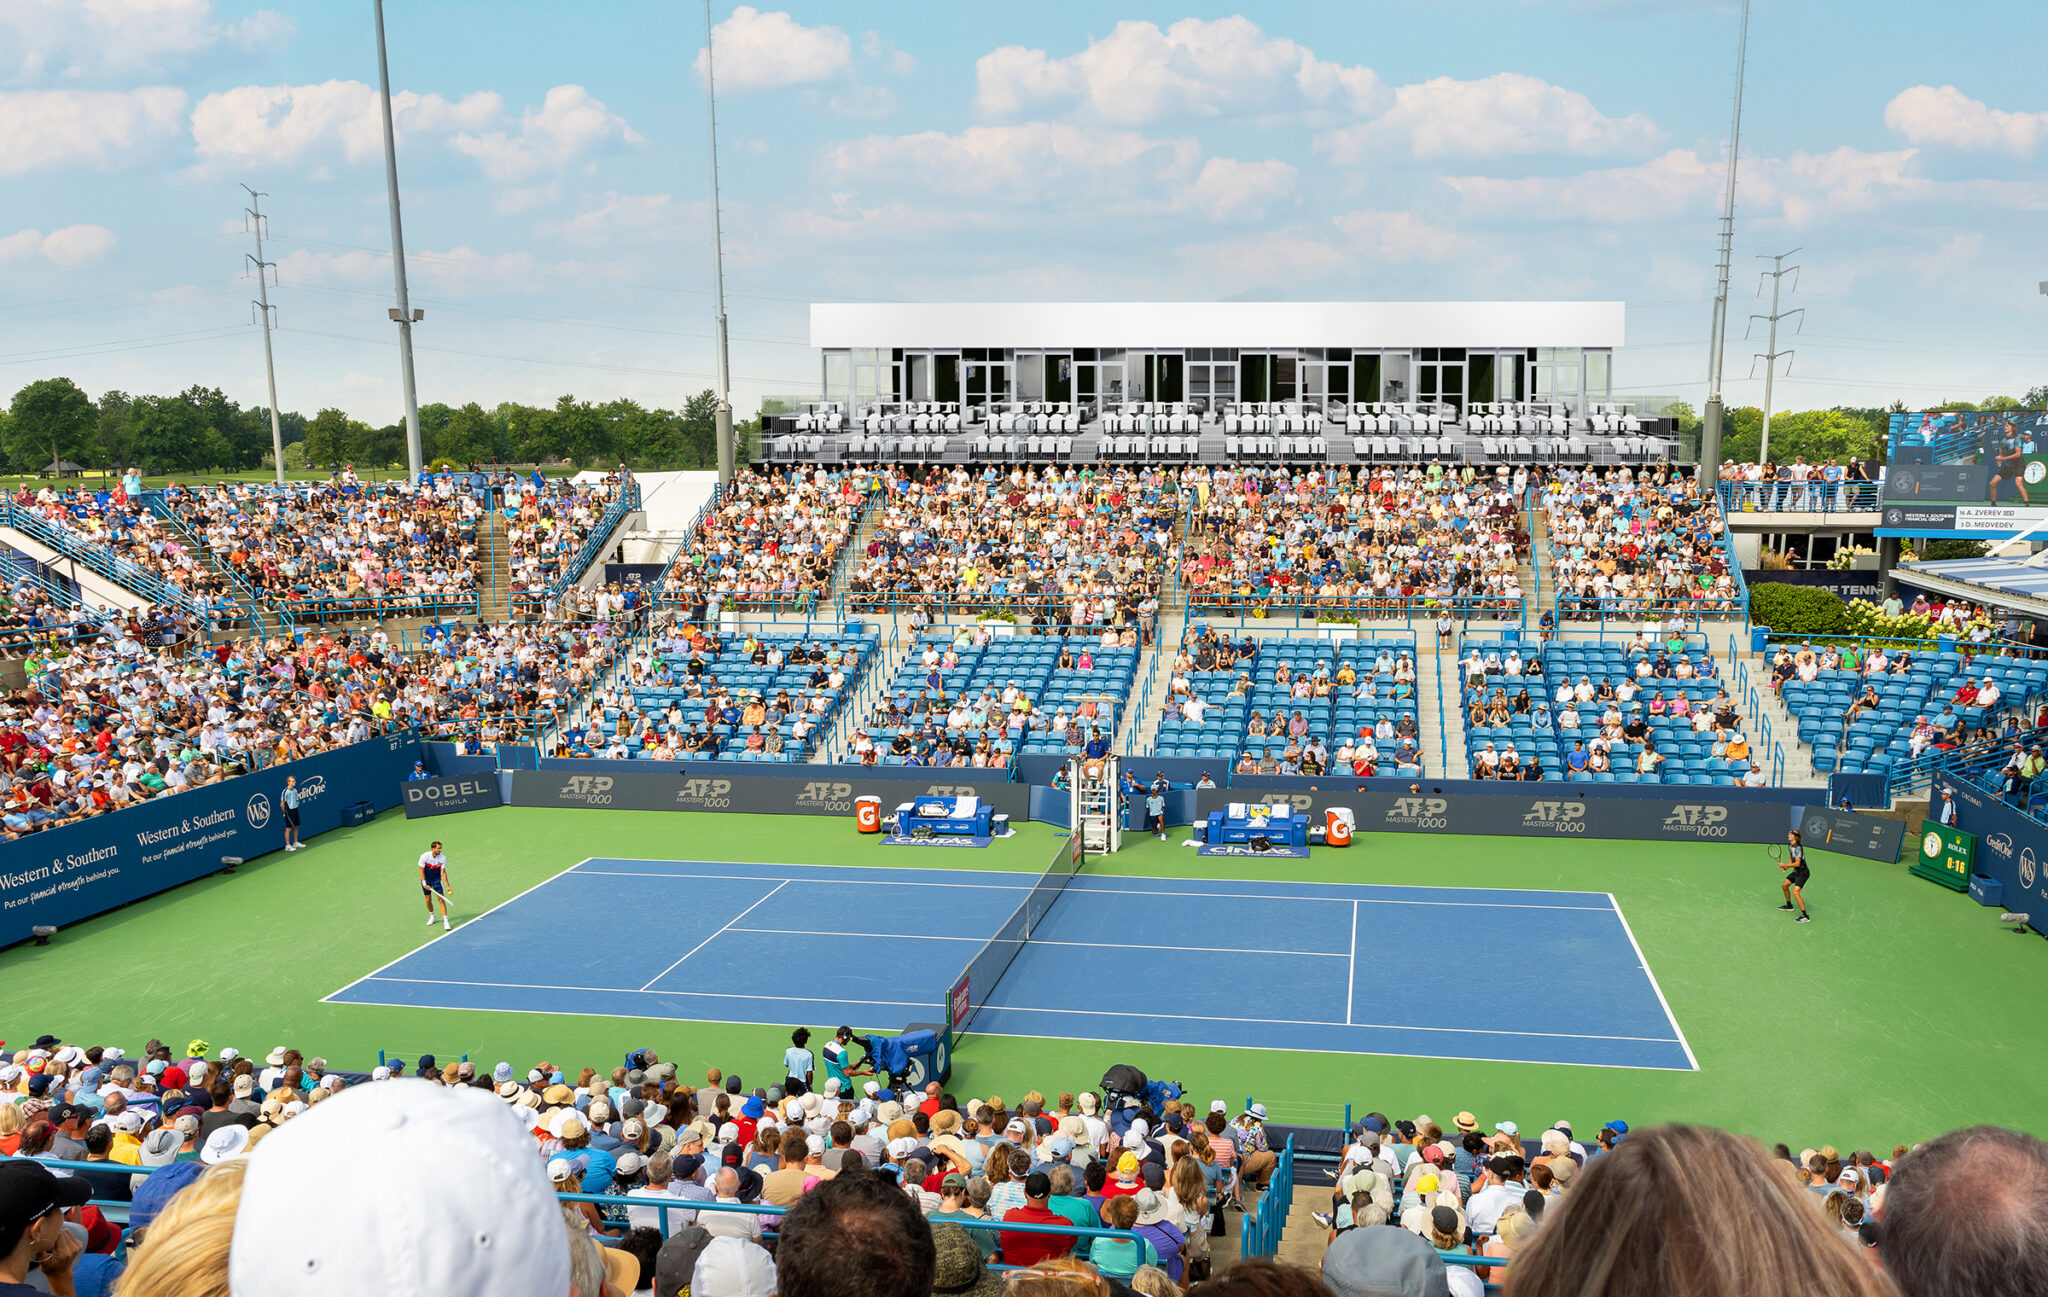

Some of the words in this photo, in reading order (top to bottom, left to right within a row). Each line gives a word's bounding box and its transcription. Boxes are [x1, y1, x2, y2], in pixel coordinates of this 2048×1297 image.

[408, 780, 489, 802] DOBEL
[560, 775, 614, 794] ATP
[676, 779, 732, 797] ATP
[796, 782, 852, 800] ATP
[434, 798, 468, 807] TEQUILA
[586, 793, 613, 805] 1000
[703, 797, 730, 808] 1000
[824, 801, 851, 812] 1000
[1385, 797, 1448, 817] ATP
[859, 806, 875, 825] G
[1521, 801, 1586, 821] ATP
[1661, 805, 1728, 825] ATP
[136, 825, 180, 847] Western
[181, 819, 192, 834] &
[192, 808, 235, 830] Southern
[1331, 819, 1350, 838] G
[1417, 817, 1448, 829] 1000
[1555, 821, 1585, 833] 1000
[1662, 824, 1697, 832] MASTERS
[1696, 825, 1728, 837] 1000
[142, 855, 152, 864] Put
[153, 852, 162, 860] our
[163, 842, 185, 860] financial
[185, 835, 208, 849] strength
[208, 830, 226, 842] behind
[1209, 845, 1293, 855] CINAS
[1948, 843, 1967, 855] ROLEX
[1986, 834, 2013, 858] CreditOne
[0, 866, 50, 890] Western
[52, 858, 65, 875] &
[66, 845, 118, 870] Southern
[4, 900, 17, 909] Put
[17, 896, 28, 905] our
[30, 884, 56, 904] financial
[57, 875, 85, 891] strength
[85, 869, 107, 883] behind
